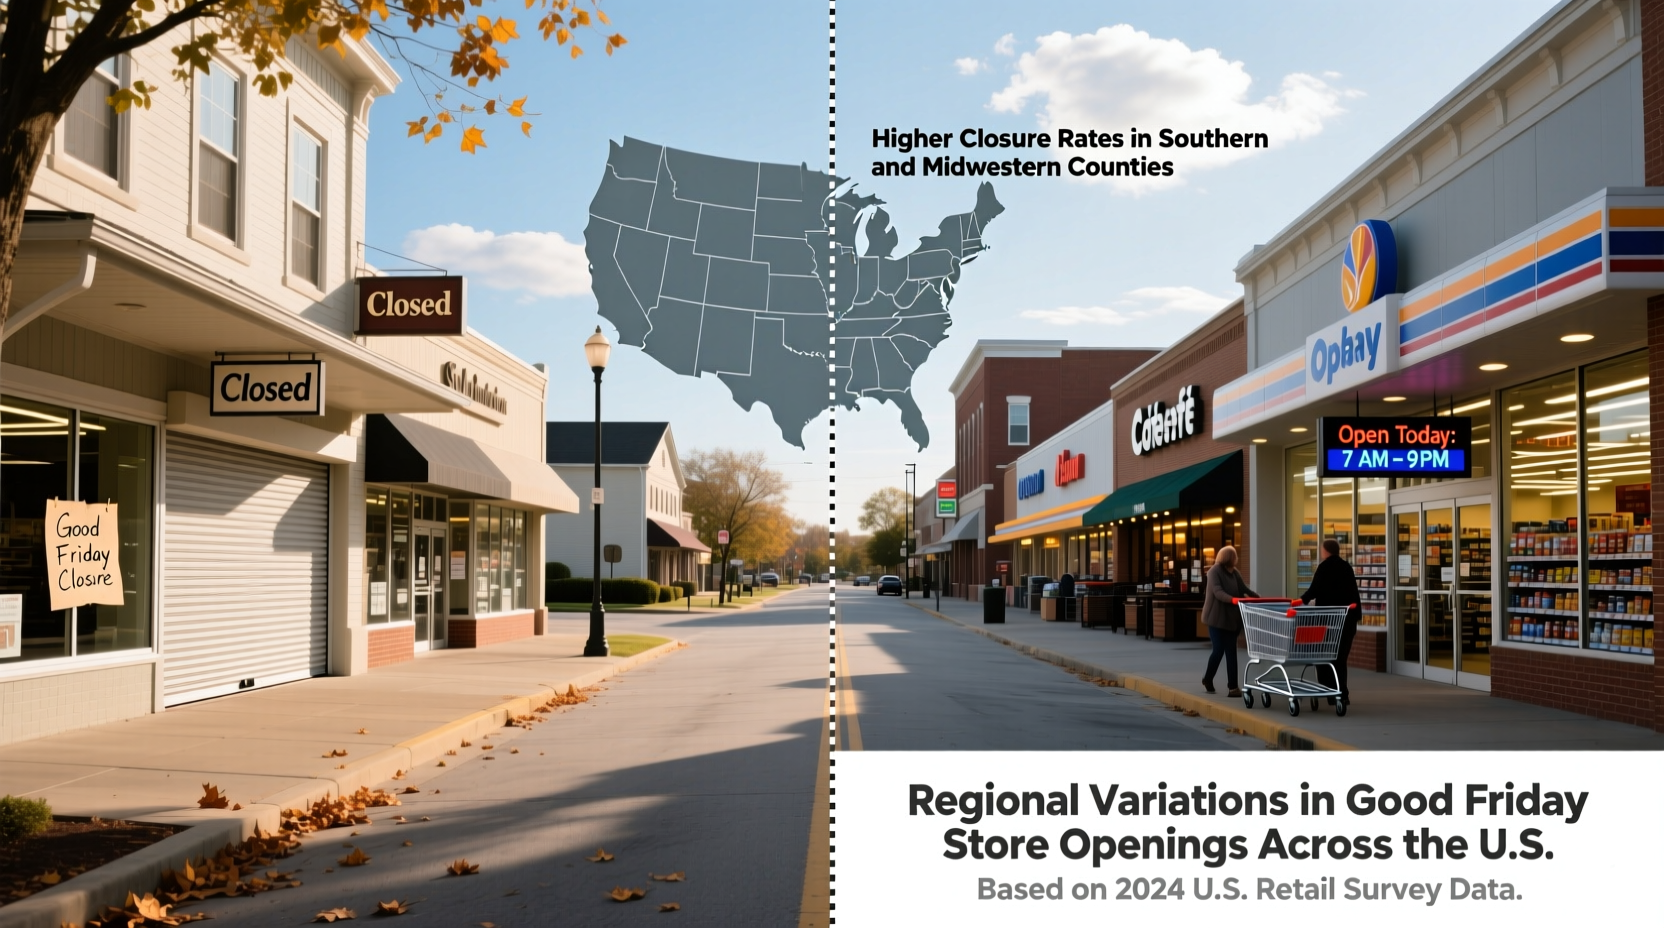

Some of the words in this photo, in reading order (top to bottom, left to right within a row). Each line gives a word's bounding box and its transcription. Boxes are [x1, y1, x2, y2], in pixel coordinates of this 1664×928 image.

[366, 290, 453, 317] Closed
[220, 371, 312, 402] Closed
[1338, 424, 1390, 449] Open
[1394, 424, 1456, 449] Today:
[1342, 449, 1354, 468] 7
[56, 512, 100, 538] Good
[56, 542, 110, 571] Friday
